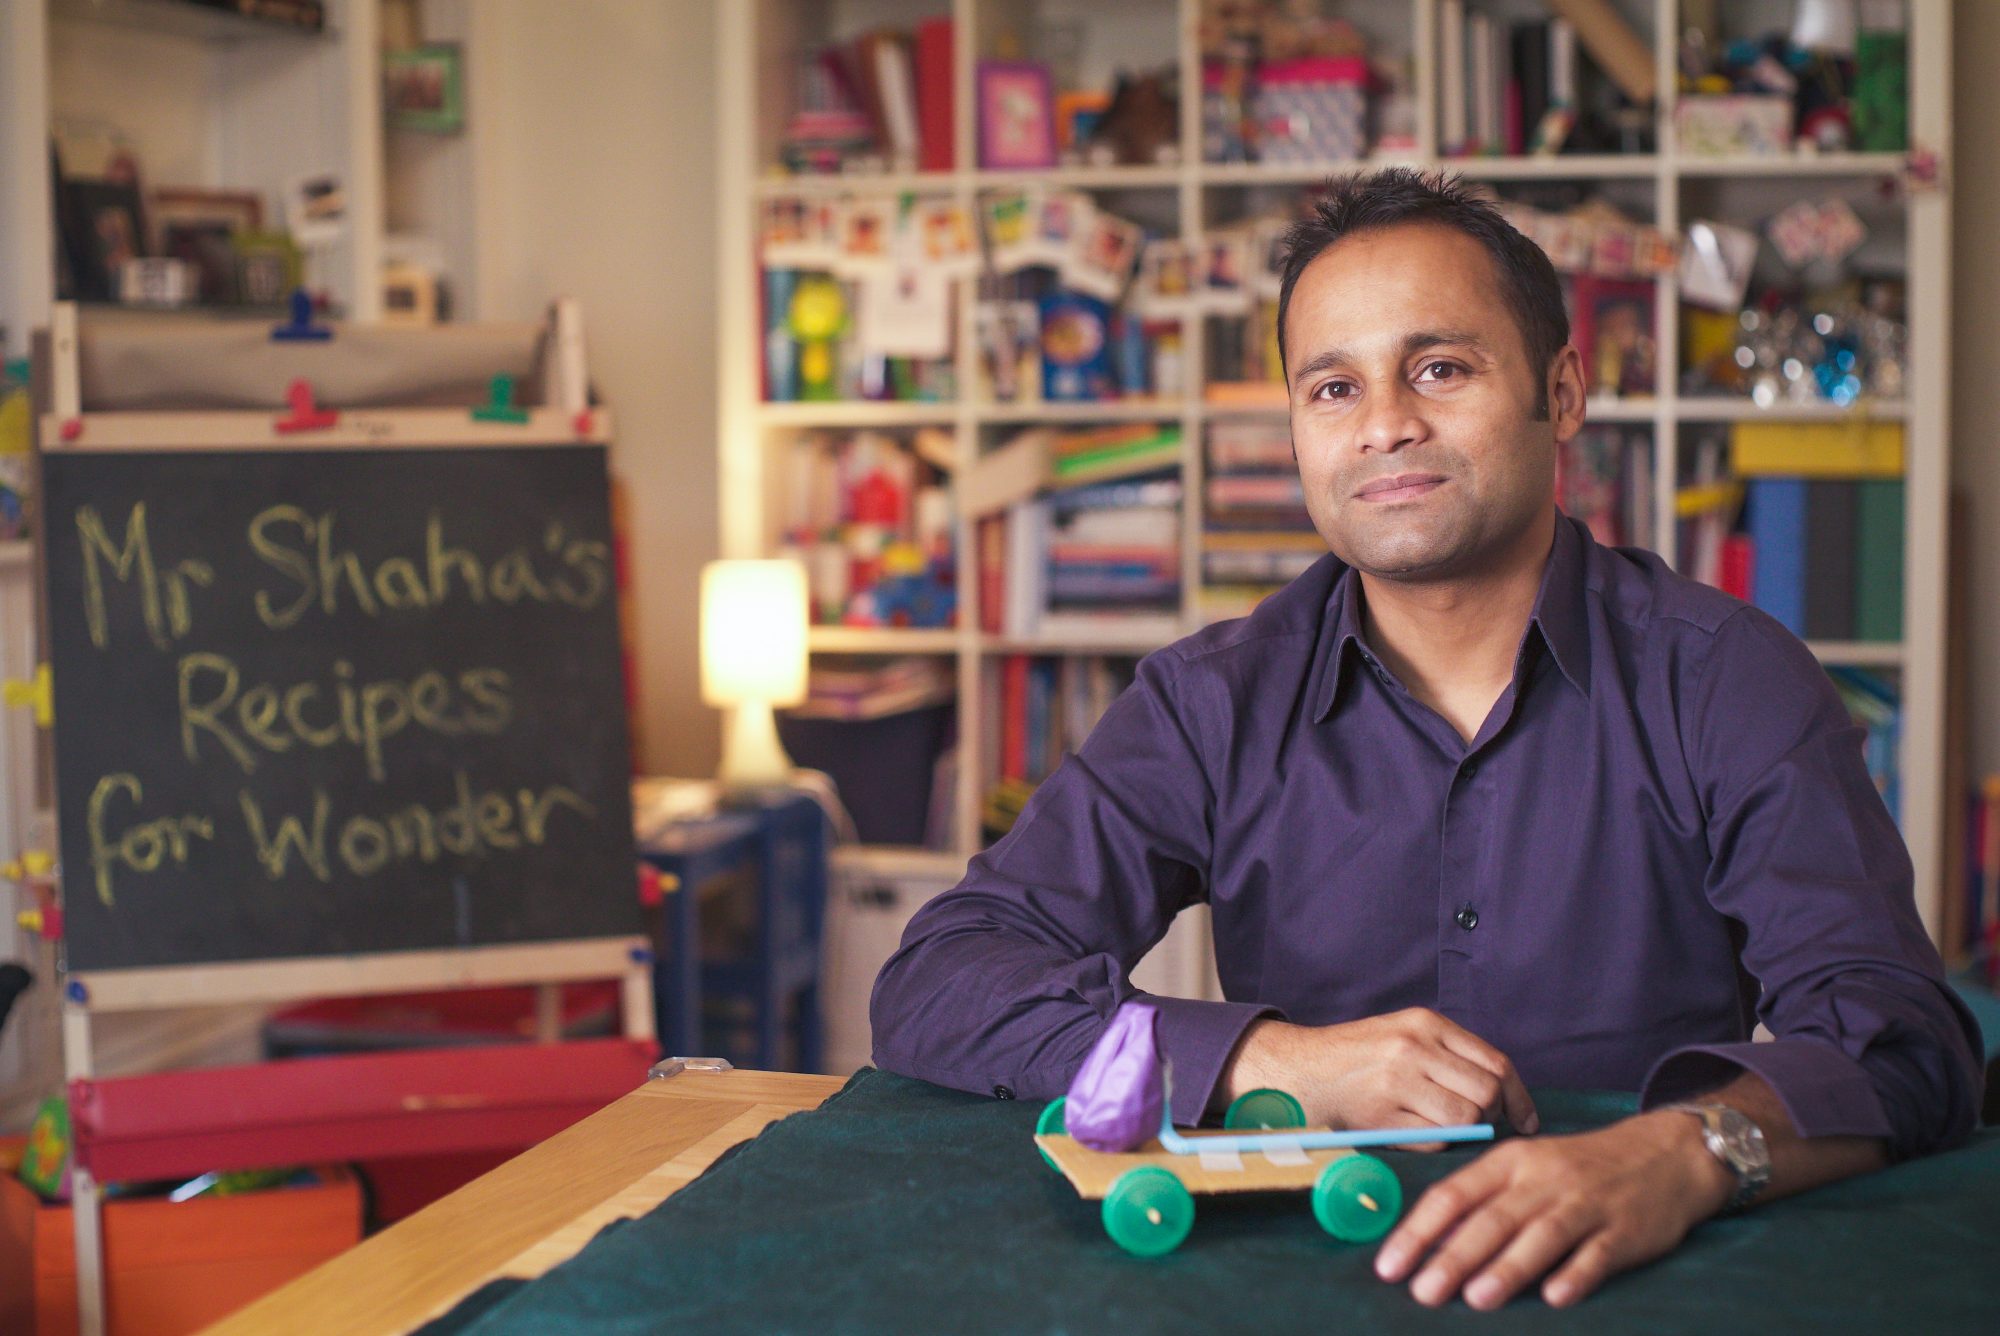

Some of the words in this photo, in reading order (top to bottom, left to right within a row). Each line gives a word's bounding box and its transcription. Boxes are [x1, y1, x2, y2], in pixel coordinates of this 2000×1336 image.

[75, 500, 214, 650] Mr
[248, 503, 609, 630] Shaha's
[178, 651, 513, 782] Recipes
[87, 772, 214, 906] for
[240, 772, 597, 884] Wonder
